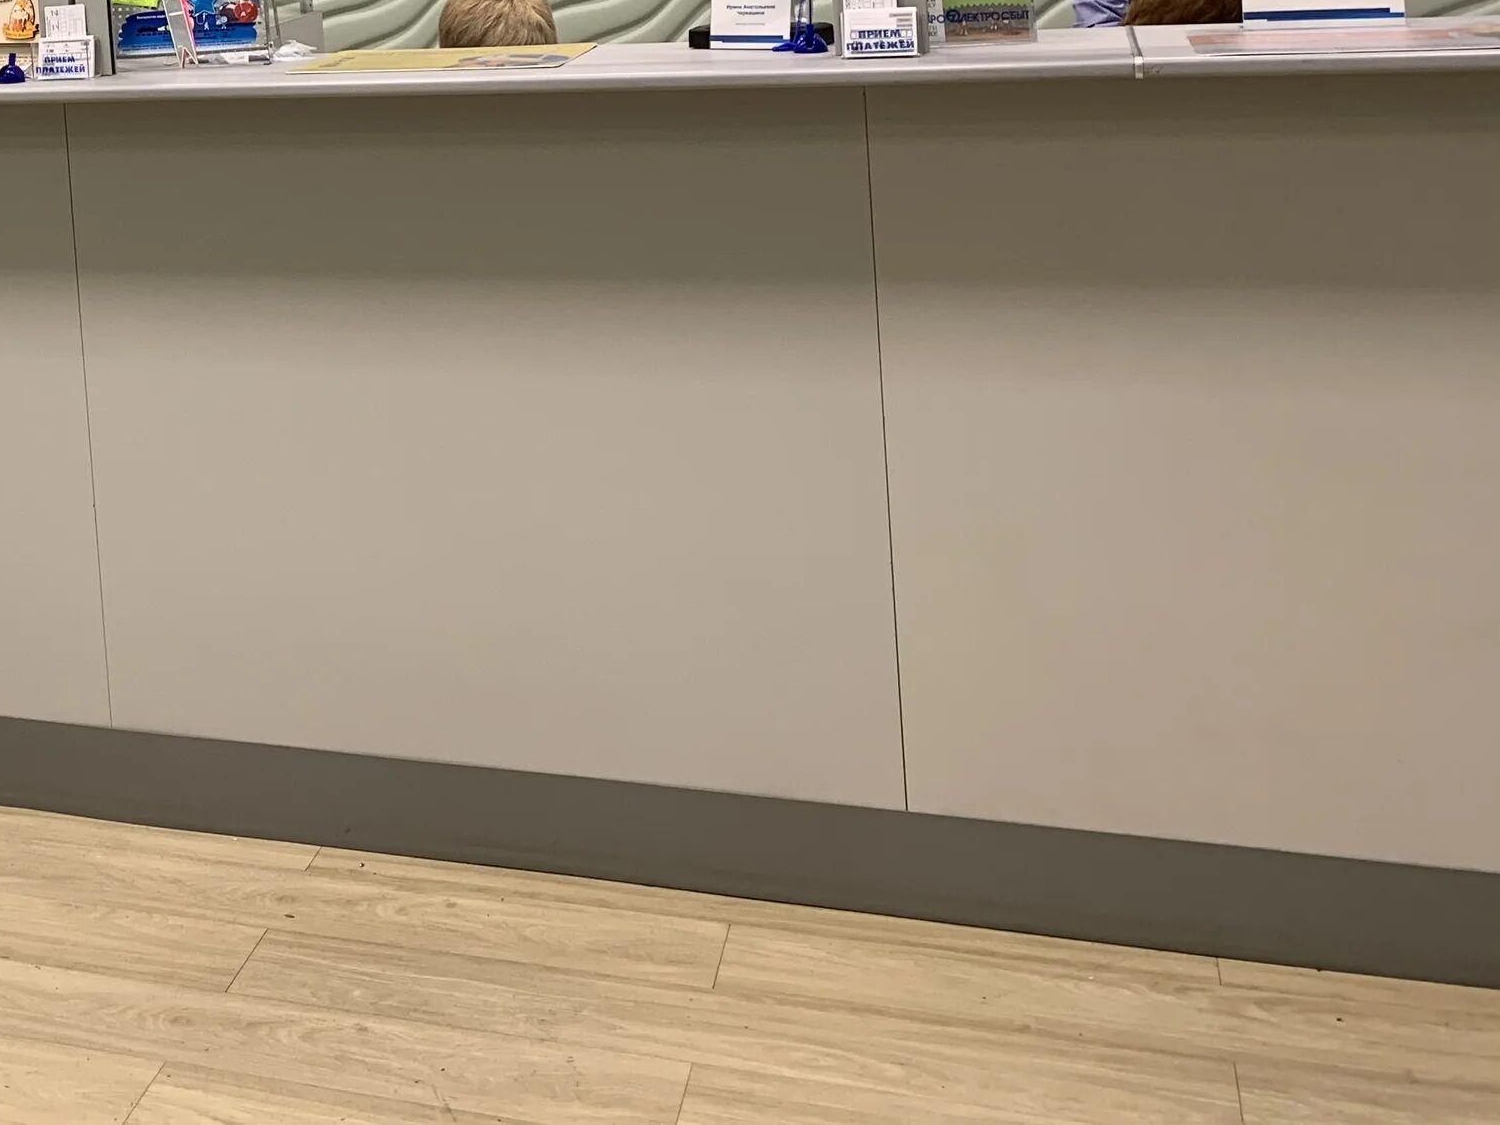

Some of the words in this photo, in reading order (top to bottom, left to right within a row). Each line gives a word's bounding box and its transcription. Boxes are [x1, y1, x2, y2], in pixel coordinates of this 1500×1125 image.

[858, 29, 901, 39] ПРИЕМ
[846, 39, 915, 51] ПЛАТЕЖЕЙ
[44, 56, 75, 64] ПРИЕМ
[36, 64, 85, 74] ПЛАТЕЖЕЙ
